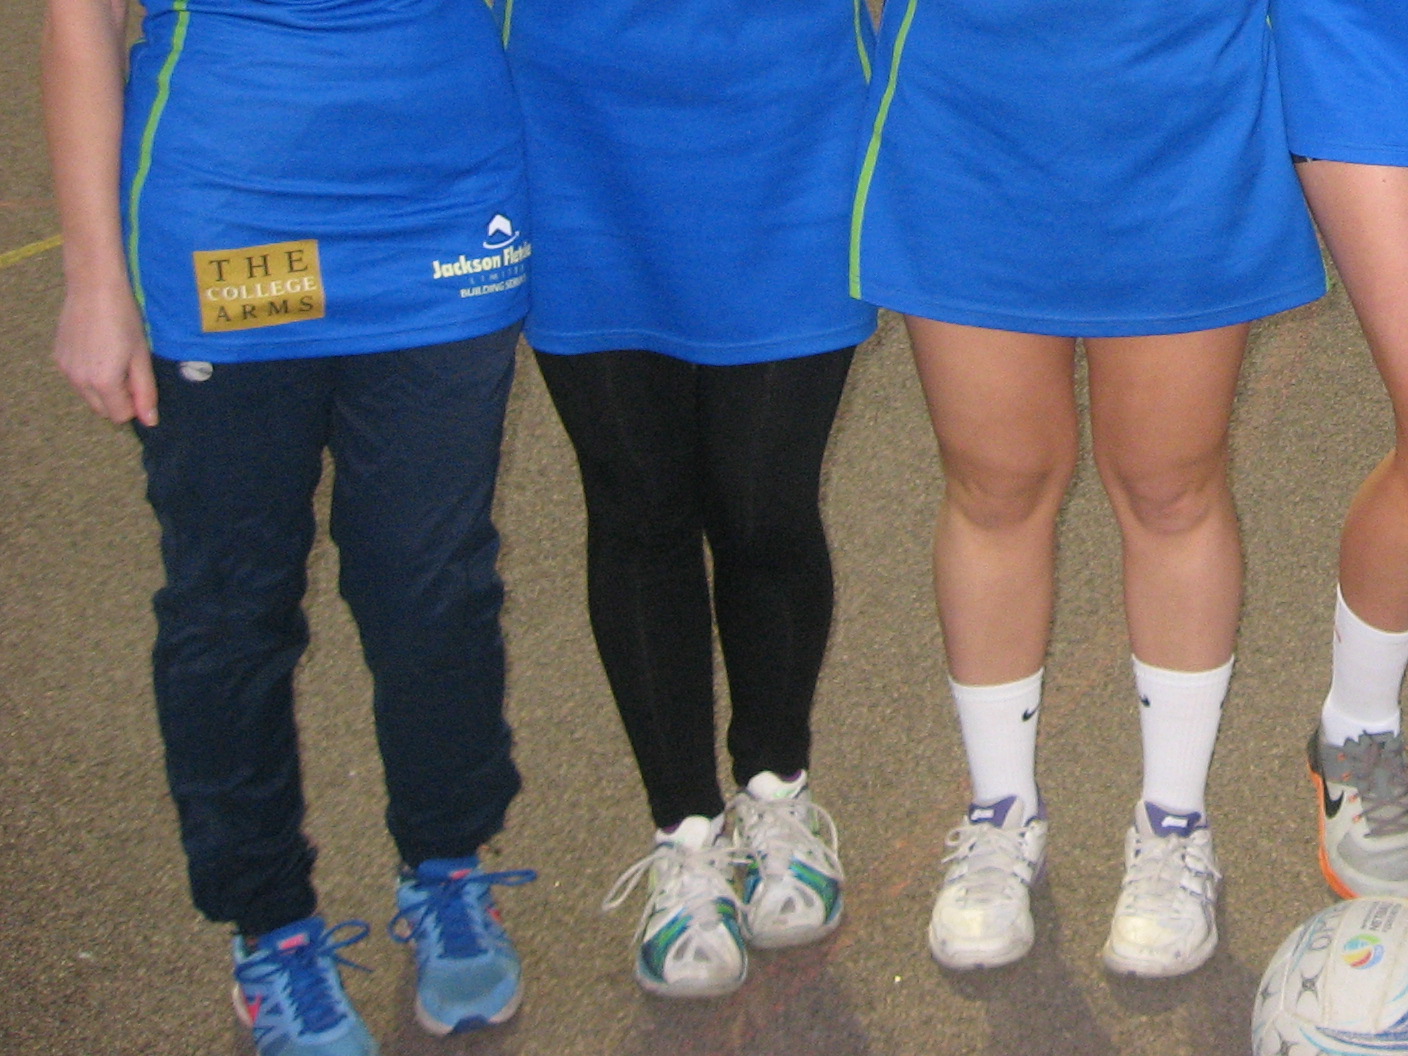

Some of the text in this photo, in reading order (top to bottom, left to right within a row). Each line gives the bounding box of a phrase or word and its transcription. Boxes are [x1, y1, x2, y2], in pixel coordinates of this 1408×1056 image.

[209, 249, 309, 282] THE
[432, 255, 501, 279] Jackson
[207, 276, 317, 302] COLLEGE
[215, 296, 314, 323] ARMS
